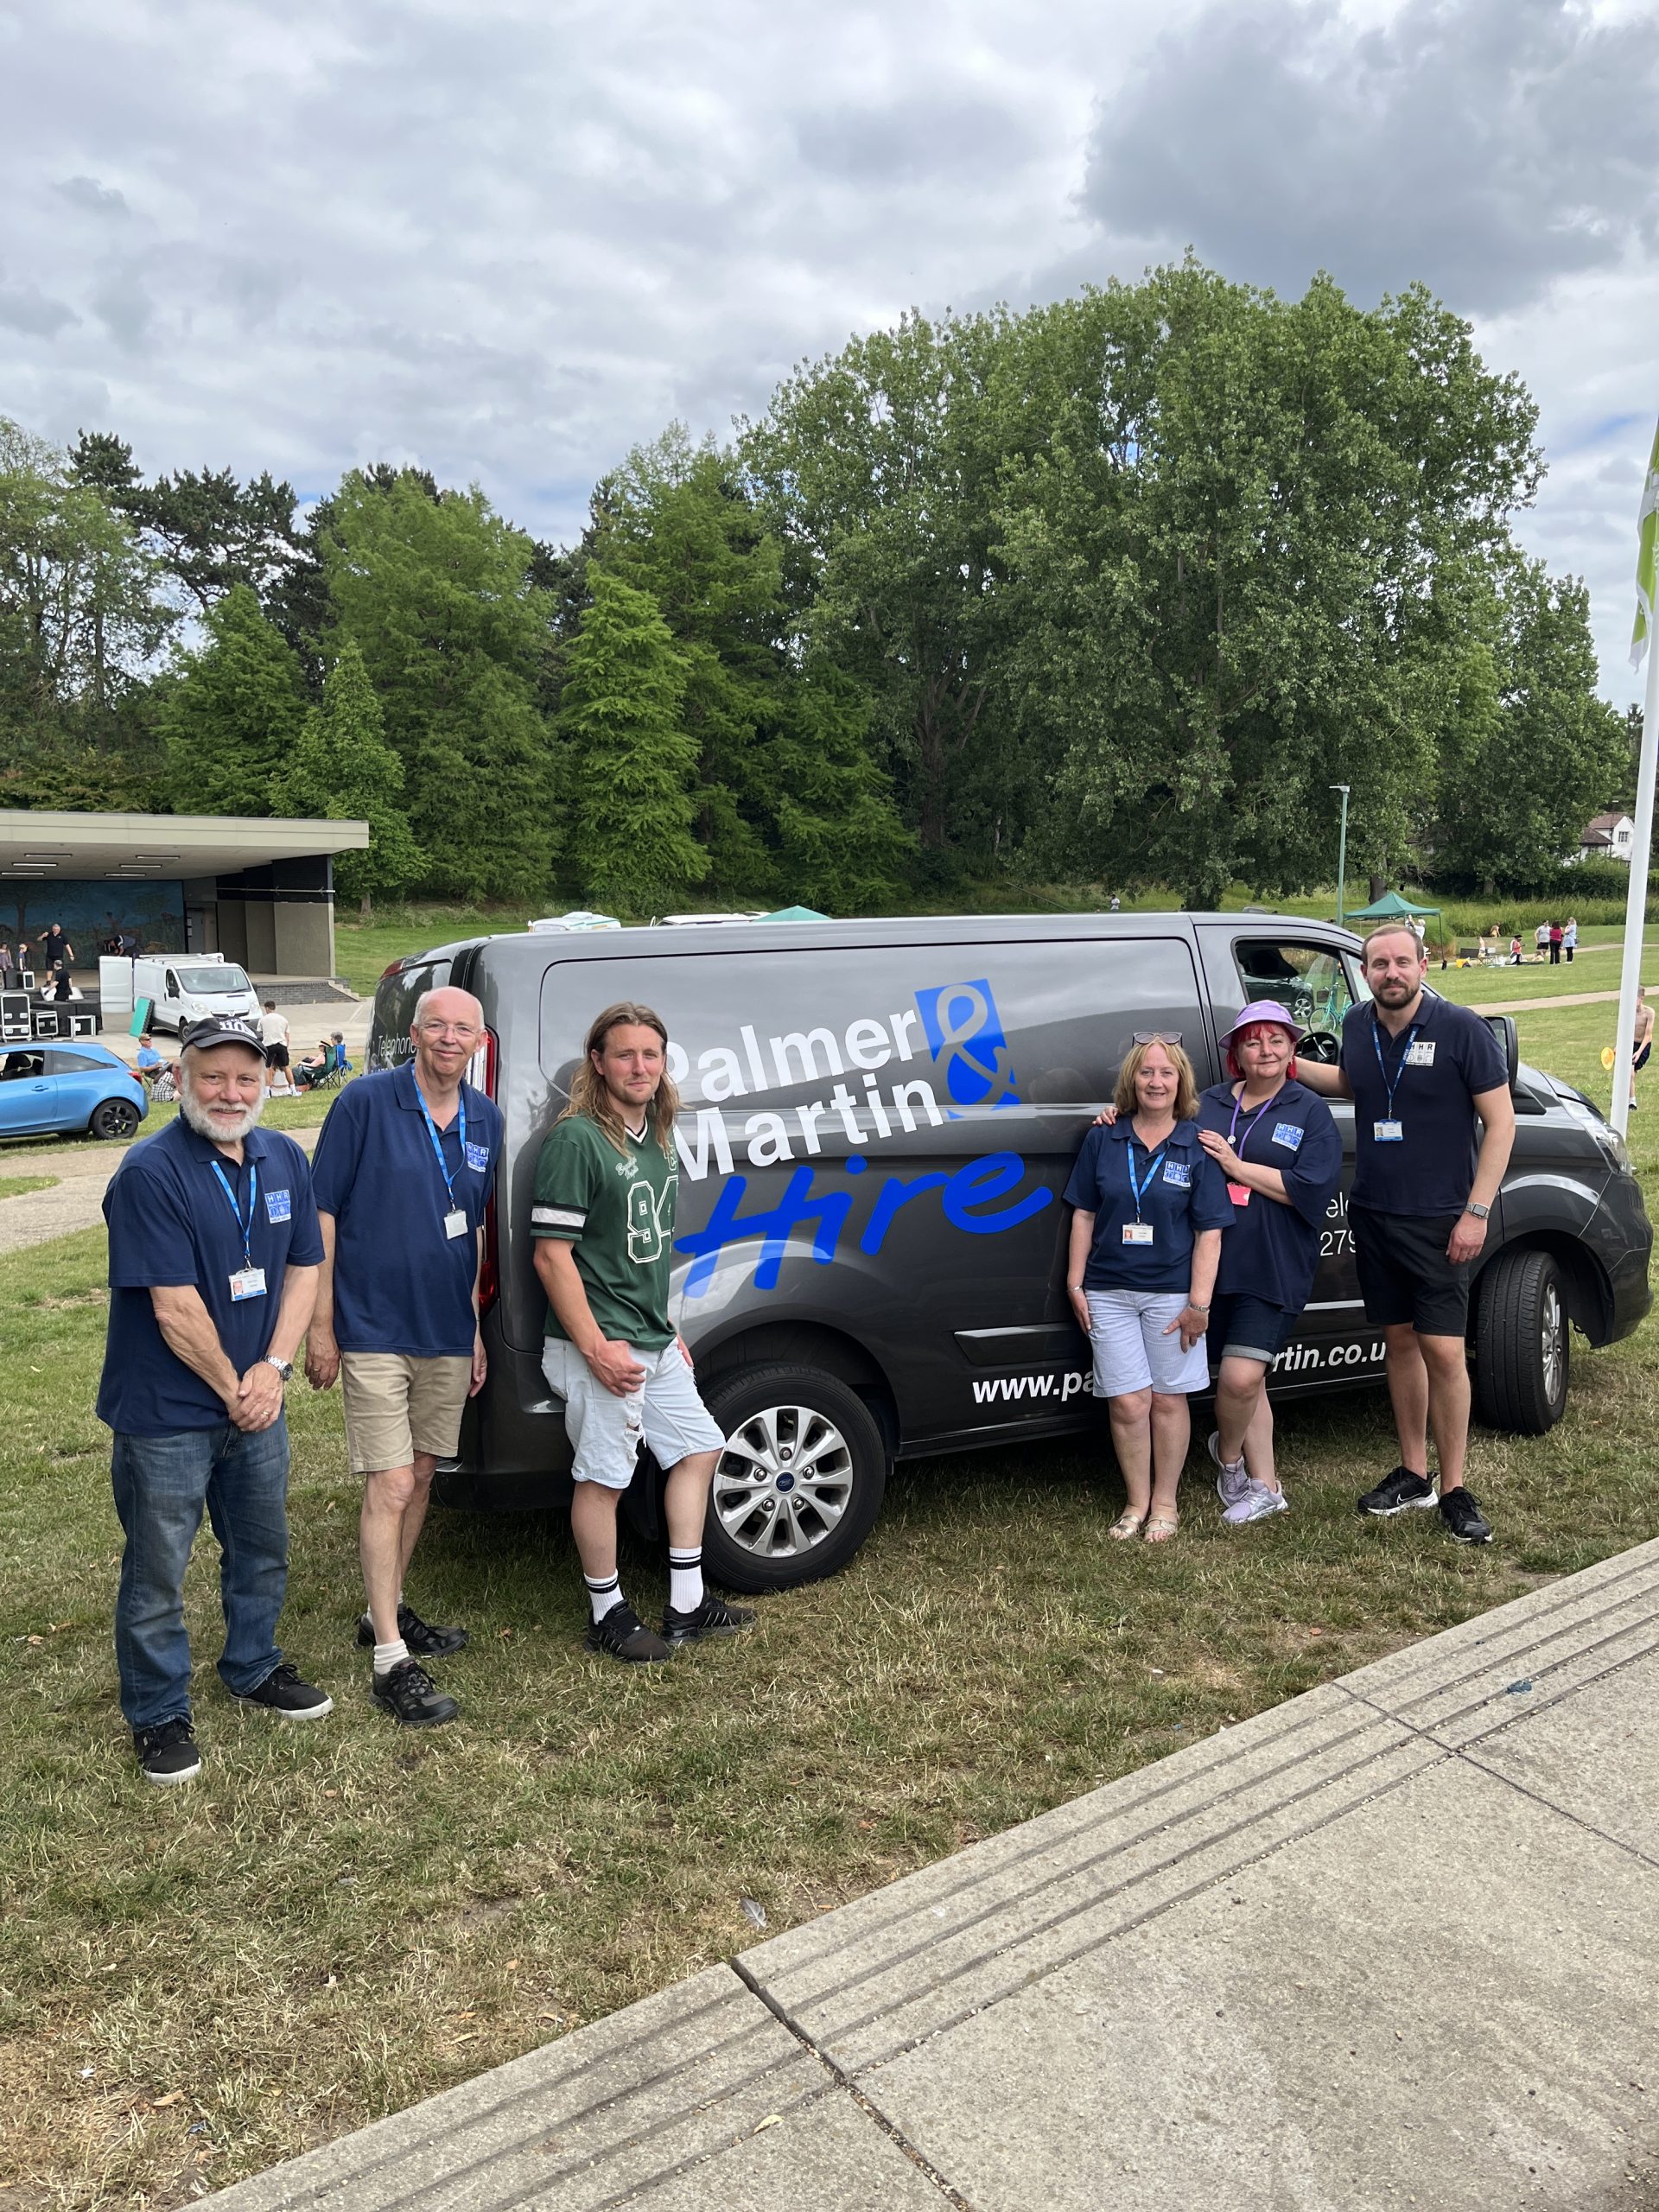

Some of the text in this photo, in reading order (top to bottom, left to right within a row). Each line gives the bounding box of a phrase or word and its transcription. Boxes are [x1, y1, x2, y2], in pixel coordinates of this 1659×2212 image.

[673, 1073, 944, 1181] Martin
[267, 1192, 289, 1203] HHR
[674, 1151, 1053, 1297] Hire
